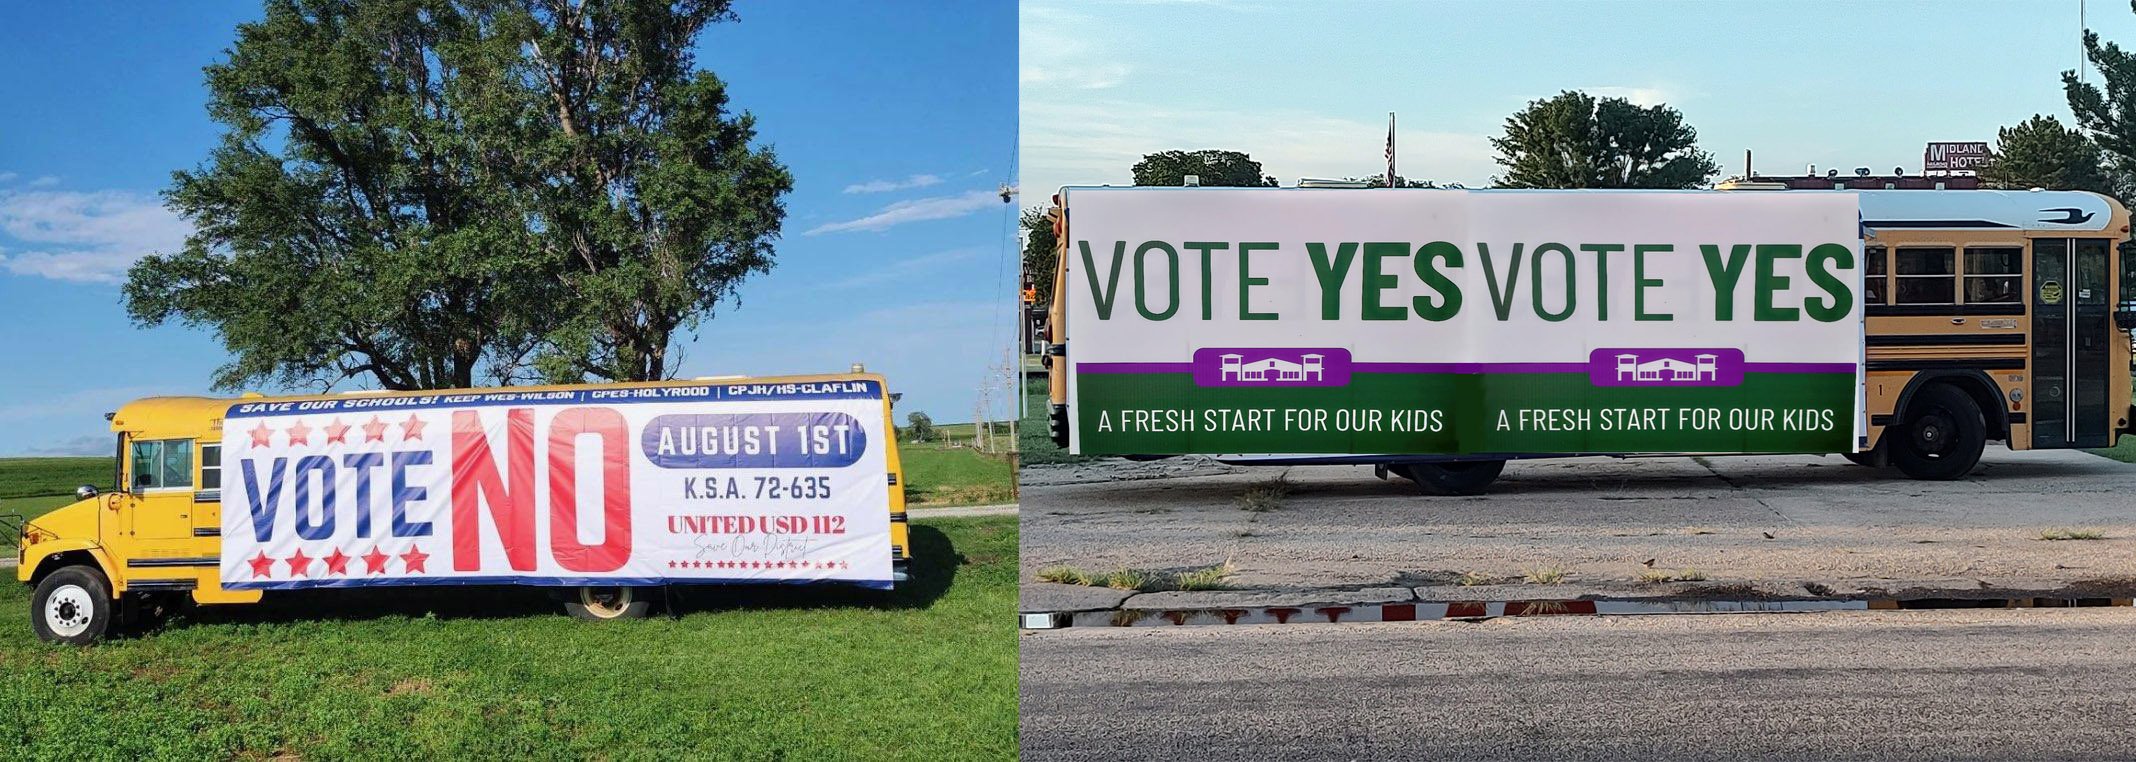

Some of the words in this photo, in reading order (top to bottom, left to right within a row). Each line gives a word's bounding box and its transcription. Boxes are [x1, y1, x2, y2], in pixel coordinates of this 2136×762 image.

[1078, 240, 1280, 321] VOTE
[1305, 241, 1464, 321] YES
[1477, 242, 1674, 322] VOTE
[1699, 243, 1854, 322] YES
[239, 402, 292, 413] SAVE
[299, 400, 336, 410] OUR
[343, 395, 441, 408] SCHOOLS!
[443, 394, 481, 403] KEEP
[484, 391, 575, 402] WES-WILSON
[728, 382, 868, 397] CPJH/HS-CLAFLIN
[1878, 384, 1883, 396] 1
[1098, 409, 1113, 432] A
[1121, 409, 1195, 432] FRESH
[1204, 408, 1275, 432] START
[1285, 408, 1327, 432] FOR
[1335, 409, 1382, 432] OUR
[1391, 409, 1443, 432] KIDS
[1496, 409, 1510, 431] A
[1519, 409, 1591, 431] FRESH
[1600, 408, 1670, 431] START
[1679, 408, 1721, 431] FOR
[1730, 408, 1775, 431] OUR
[1783, 409, 1834, 431] KIDS
[658, 426, 780, 456] AUGUST
[798, 425, 850, 455] 1ST
[241, 450, 433, 542] VOTE
[452, 407, 632, 572] NO
[685, 477, 746, 499] K.S.A.
[754, 476, 831, 499] 72-635
[668, 515, 756, 534] UNITED
[760, 515, 808, 534] USD
[812, 515, 846, 534] 112
[693, 533, 727, 559] Save
[731, 534, 759, 558] Our
[763, 532, 818, 559] District
